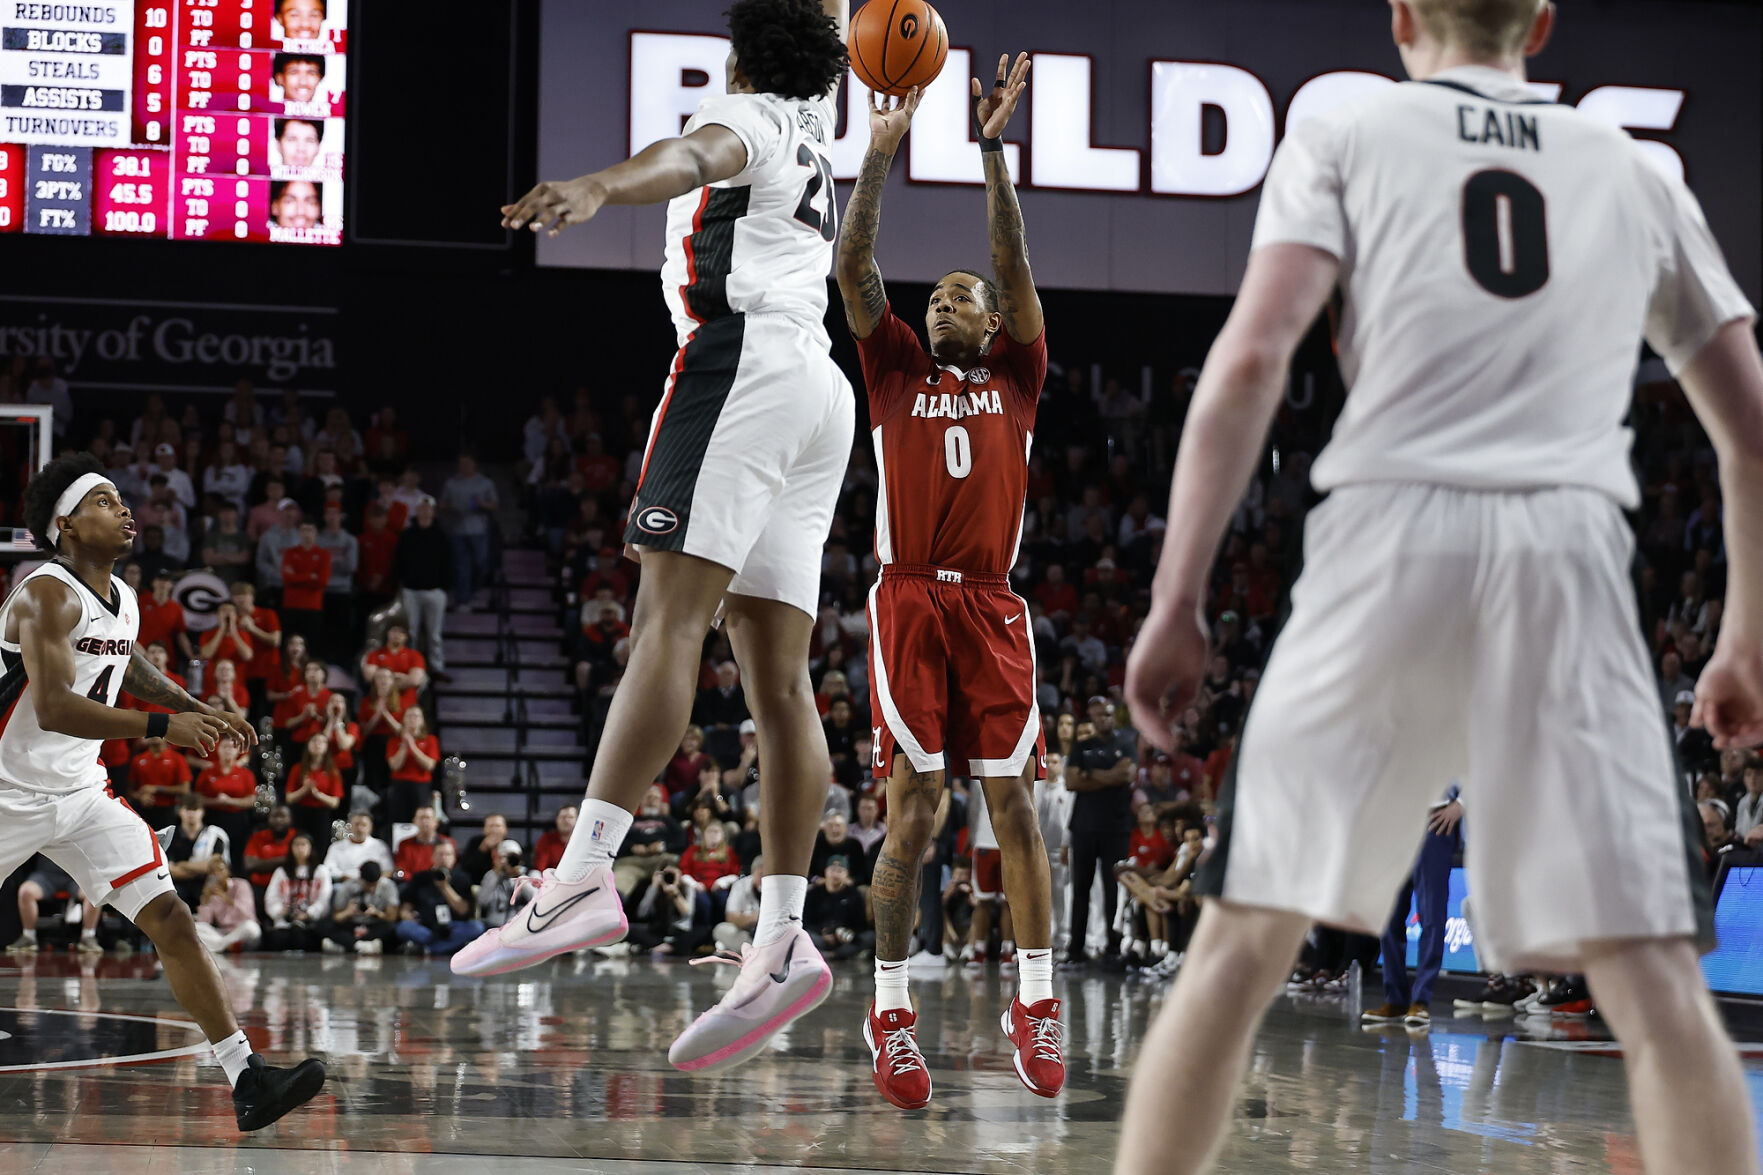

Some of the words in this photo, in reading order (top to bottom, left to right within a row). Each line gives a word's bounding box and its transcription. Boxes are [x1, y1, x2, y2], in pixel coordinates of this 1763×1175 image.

[15, 3, 117, 23] REBOUNDS
[145, 8, 167, 28] 10
[26, 30, 102, 53] BLOCKS
[148, 36, 162, 56] 0
[28, 61, 100, 80] STEALS
[147, 64, 162, 84] 6
[184, 51, 217, 69] PTS
[22, 87, 103, 110] ASSISTS
[146, 93, 161, 112] 5
[6, 116, 119, 137] TURNOVERS
[183, 115, 215, 134] PTS
[1456, 103, 1541, 153] CAIN
[109, 183, 153, 204] 45.5
[181, 178, 214, 196] PTS
[793, 143, 836, 242] 25
[105, 211, 156, 232] 100.0
[1461, 168, 1550, 299] 0
[0, 313, 91, 374] rsity
[97, 315, 151, 361] of
[153, 318, 337, 382] Georgia
[944, 425, 972, 479] 0
[76, 637, 135, 656] GEORGI
[87, 664, 116, 705] 4
